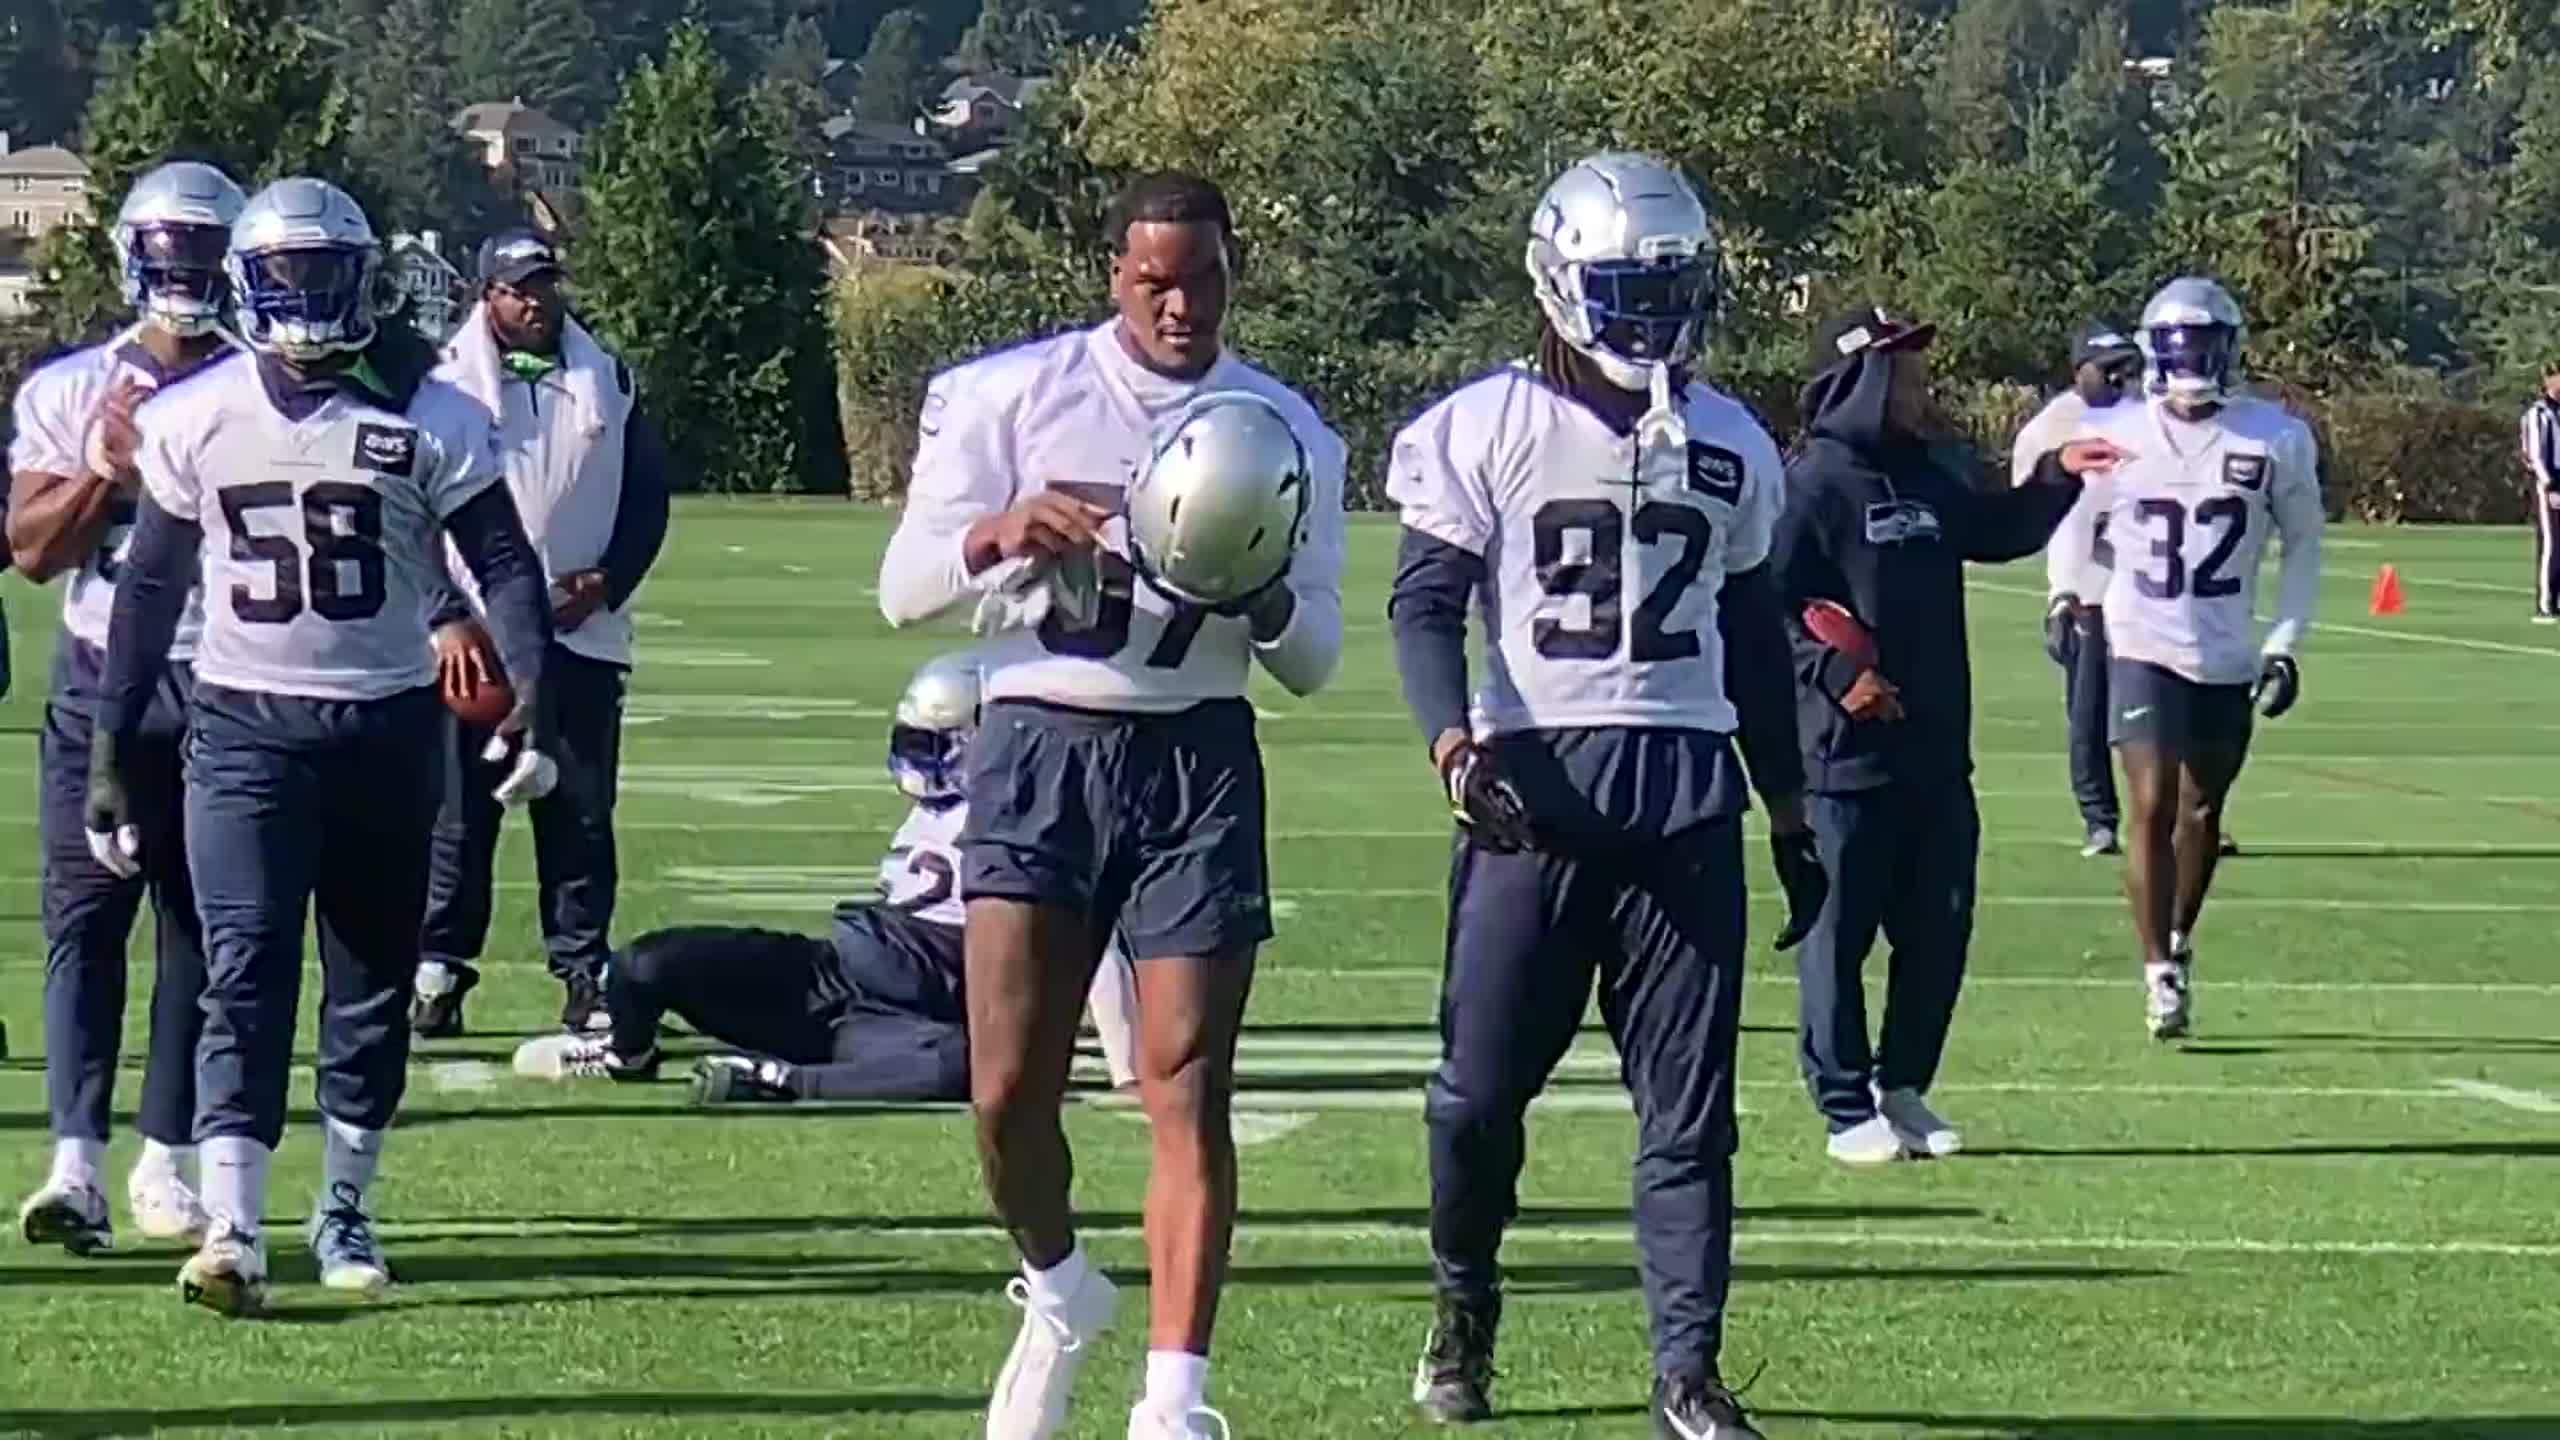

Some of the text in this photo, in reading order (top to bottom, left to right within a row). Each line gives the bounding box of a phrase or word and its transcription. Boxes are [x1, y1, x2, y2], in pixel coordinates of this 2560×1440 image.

[217, 480, 386, 624] 58
[1036, 481, 1206, 669] 5
[1533, 498, 1712, 662] 92
[2133, 496, 2247, 600] 32
